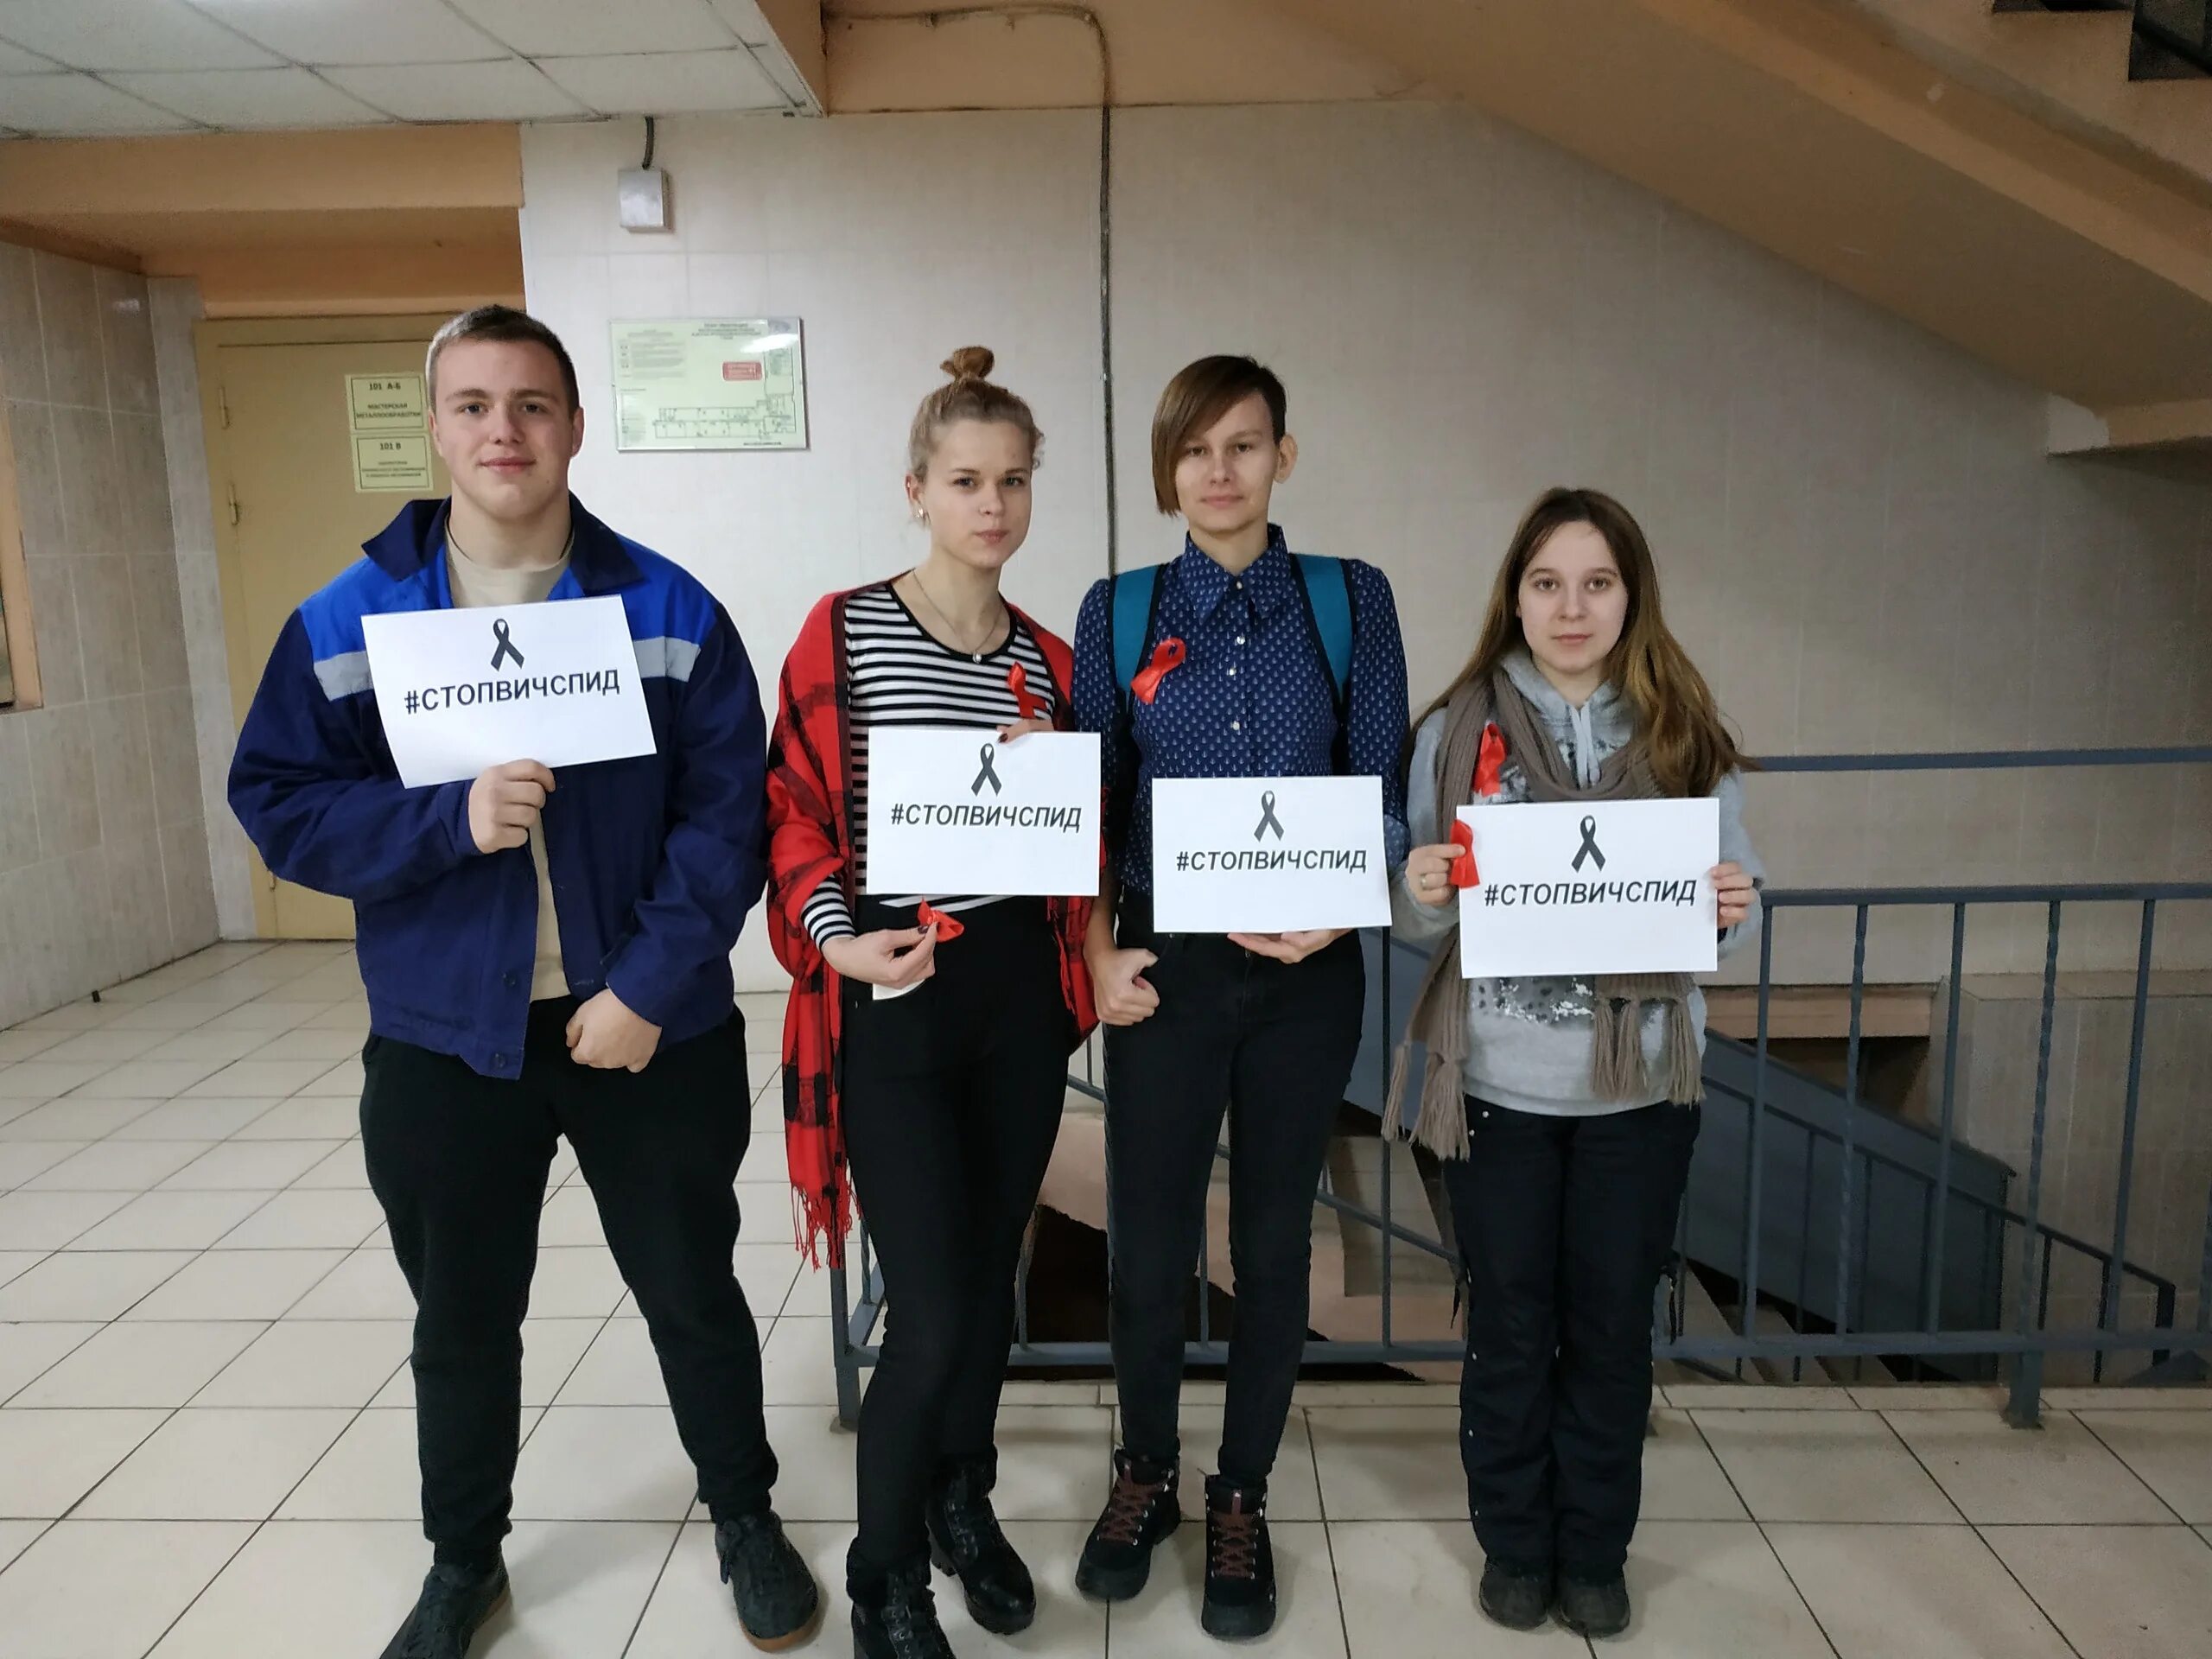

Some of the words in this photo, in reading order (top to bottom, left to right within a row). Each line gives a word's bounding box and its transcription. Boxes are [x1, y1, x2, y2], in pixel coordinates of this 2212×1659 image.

[404, 669, 620, 715] #СТОПВИЧСПИД
[891, 804, 1082, 833] #СТОПВИЧСПИД
[1176, 849, 1367, 874] #СТОПВИЧСПИД
[1484, 880, 1697, 907] #СТОПВИЧСПИД
